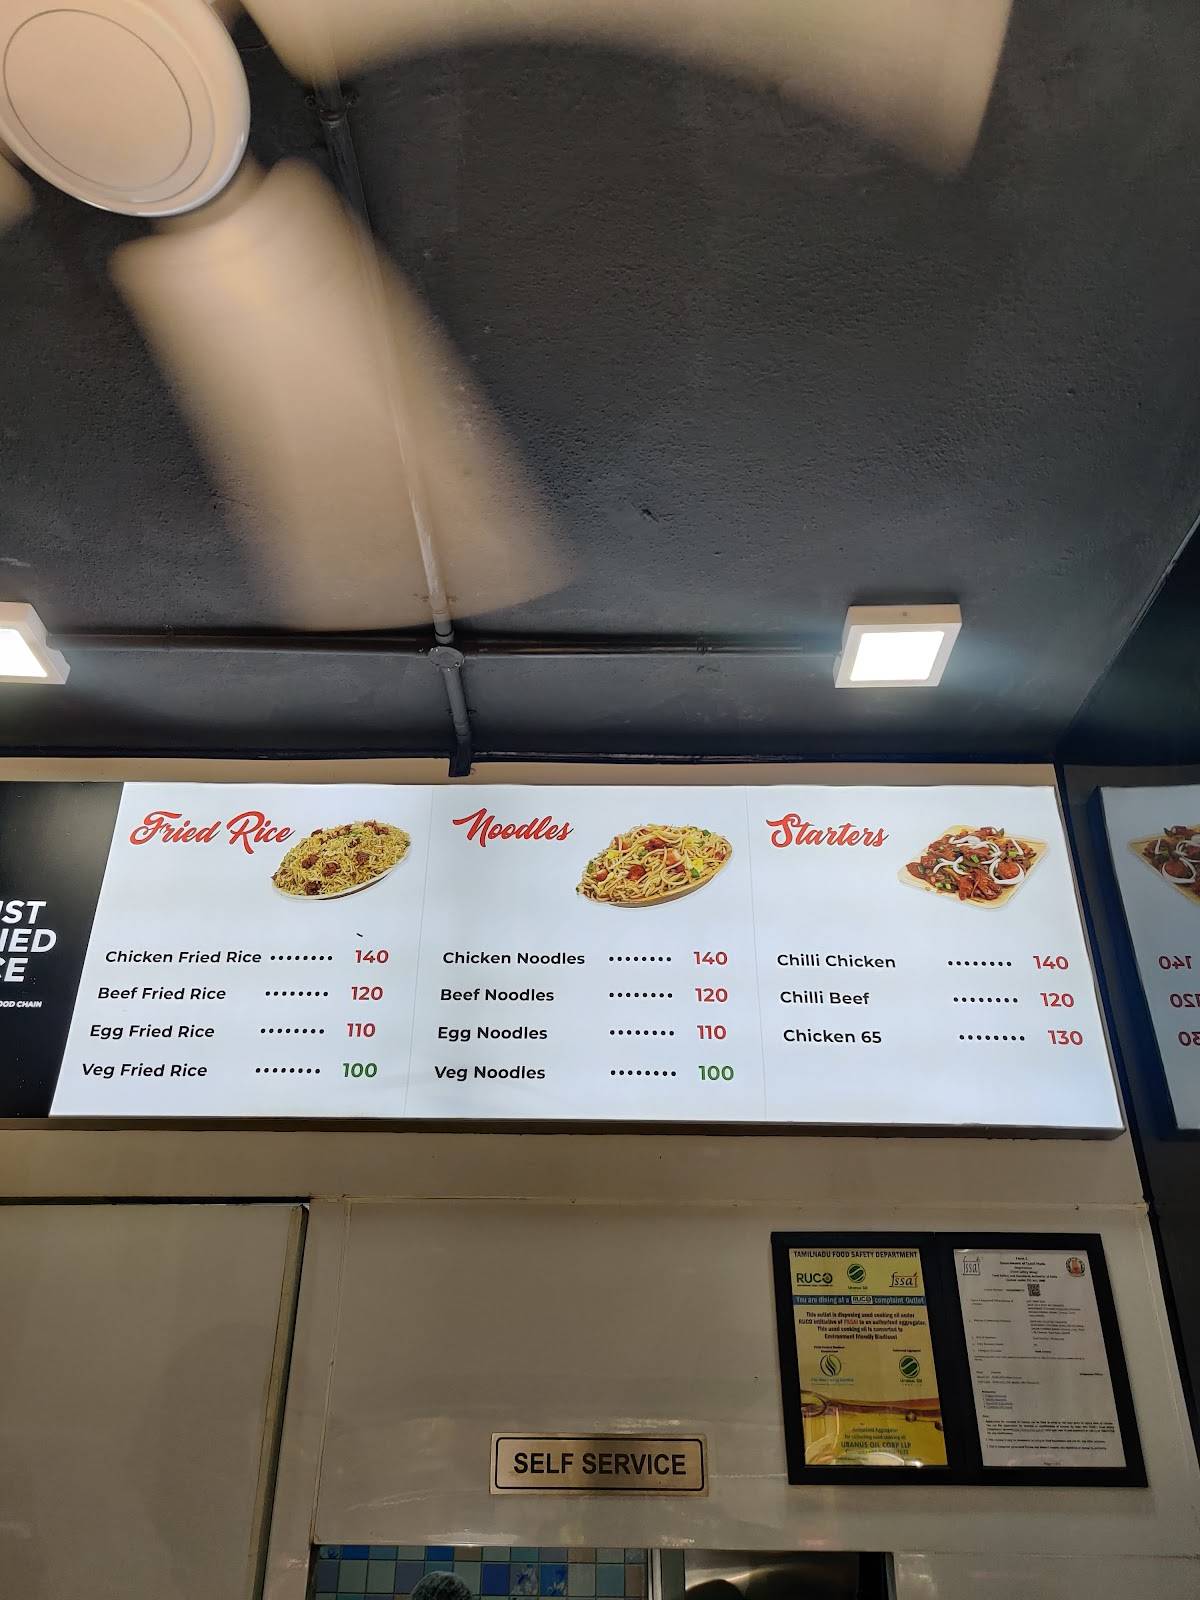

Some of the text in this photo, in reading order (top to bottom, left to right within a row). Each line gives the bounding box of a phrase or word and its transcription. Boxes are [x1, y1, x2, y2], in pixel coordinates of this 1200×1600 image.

[130, 811, 296, 854] Fried Rice
[453, 808, 574, 847] Noodles
[766, 814, 889, 848] Starters
[106, 950, 388, 963] Chicken Fried Rice 140
[443, 952, 727, 965] Chicken Noodles 140
[778, 954, 1068, 969] Chilli Chicken 140
[98, 987, 383, 1000] Beef Fried Rice 120
[441, 988, 727, 1002] Beef Noodles 120
[781, 991, 1074, 1007] Chilli Beef 120
[90, 1023, 375, 1039] Egg Fried Rice 110
[438, 1025, 726, 1042] Egg Noodles 110
[784, 1030, 1083, 1045] Chicken 65 130
[83, 1063, 377, 1079] Veg Fried Rice 100
[435, 1066, 734, 1081] Veg Noodles 100
[797, 1272, 832, 1284] RUCO
[514, 1453, 686, 1475] SELF SERVICE
